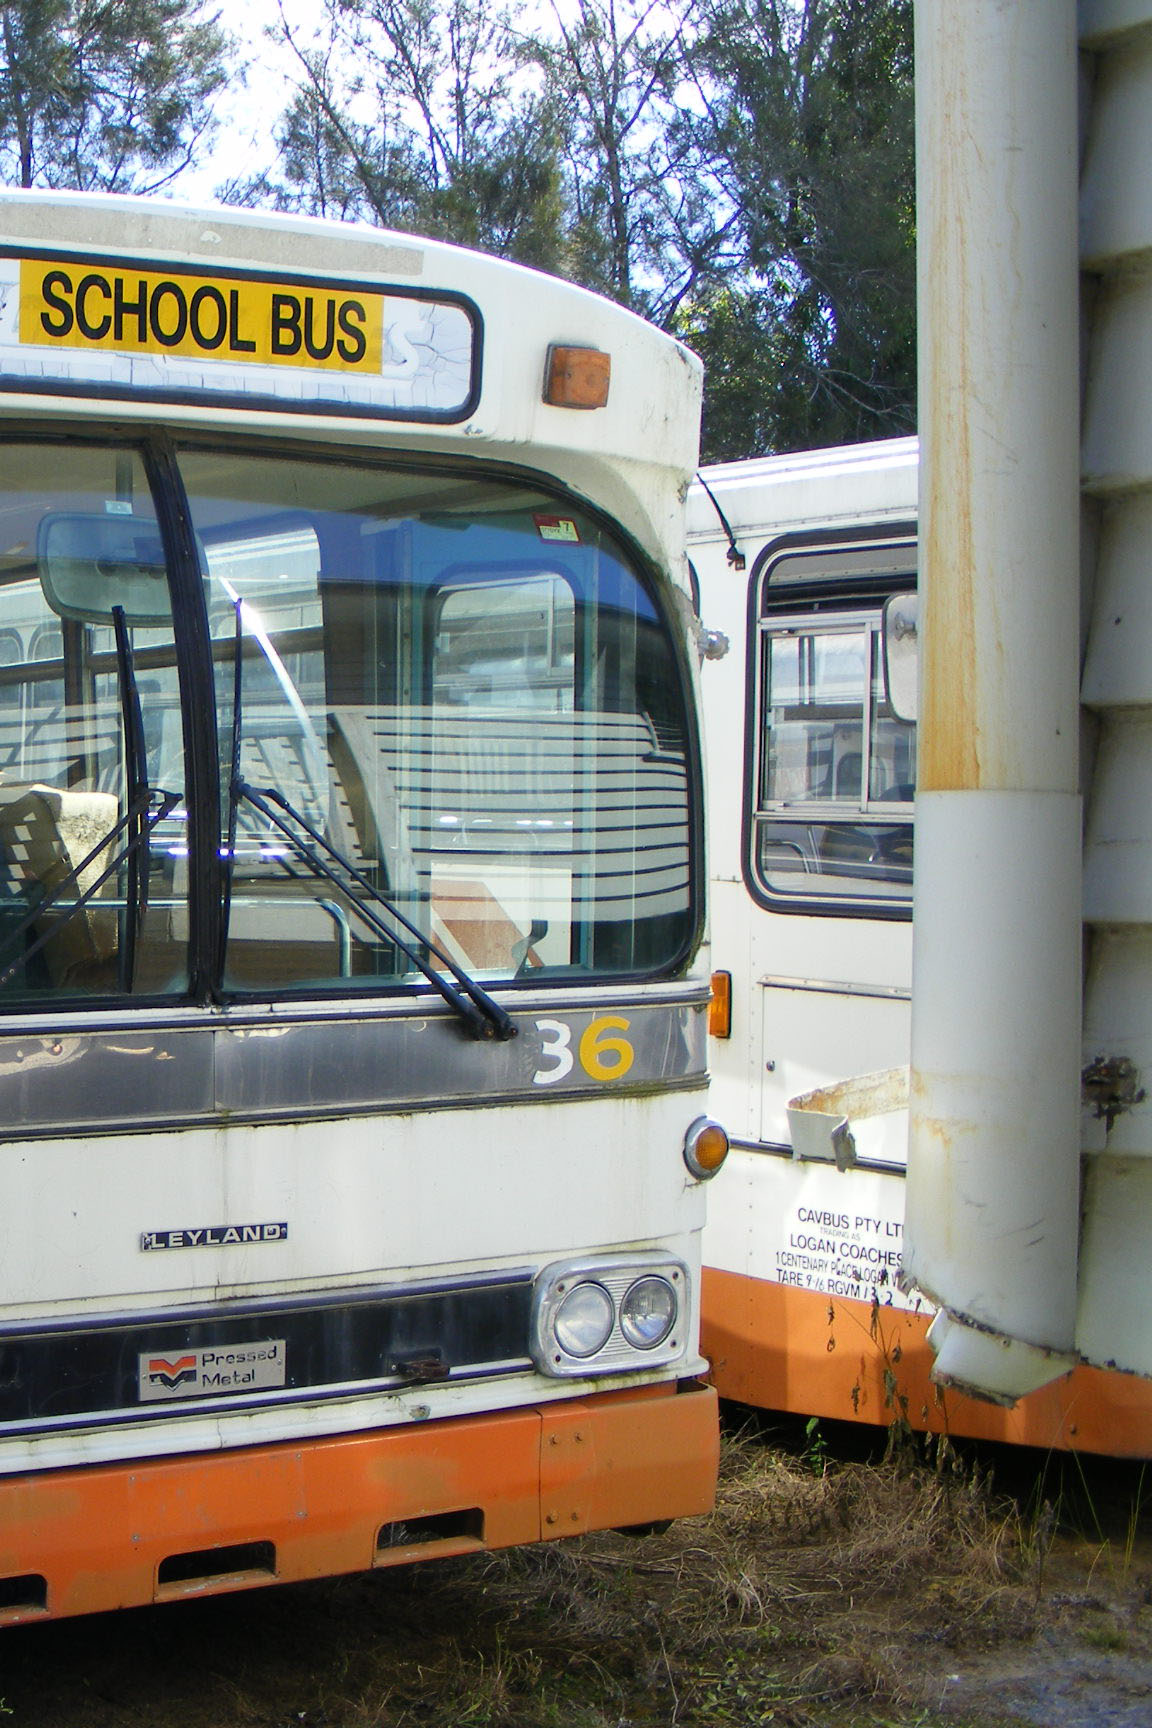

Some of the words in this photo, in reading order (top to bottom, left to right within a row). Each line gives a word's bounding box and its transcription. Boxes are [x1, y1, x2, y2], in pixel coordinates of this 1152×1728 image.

[40, 270, 256, 352] SCHOOL
[271, 293, 366, 363] BUS
[532, 1015, 635, 1085] 36
[797, 1207, 850, 1230] CAVBUS
[855, 1216, 882, 1234] PTY
[150, 1224, 281, 1249] LEYLAND
[790, 1233, 836, 1255] LOGAN
[839, 1242, 903, 1267] COACHES
[781, 1251, 828, 1273] CENTENARY
[776, 1267, 804, 1287] TARE
[827, 1278, 860, 1299] RGVM
[201, 1345, 278, 1368] Pressed
[201, 1368, 256, 1389] Metal
